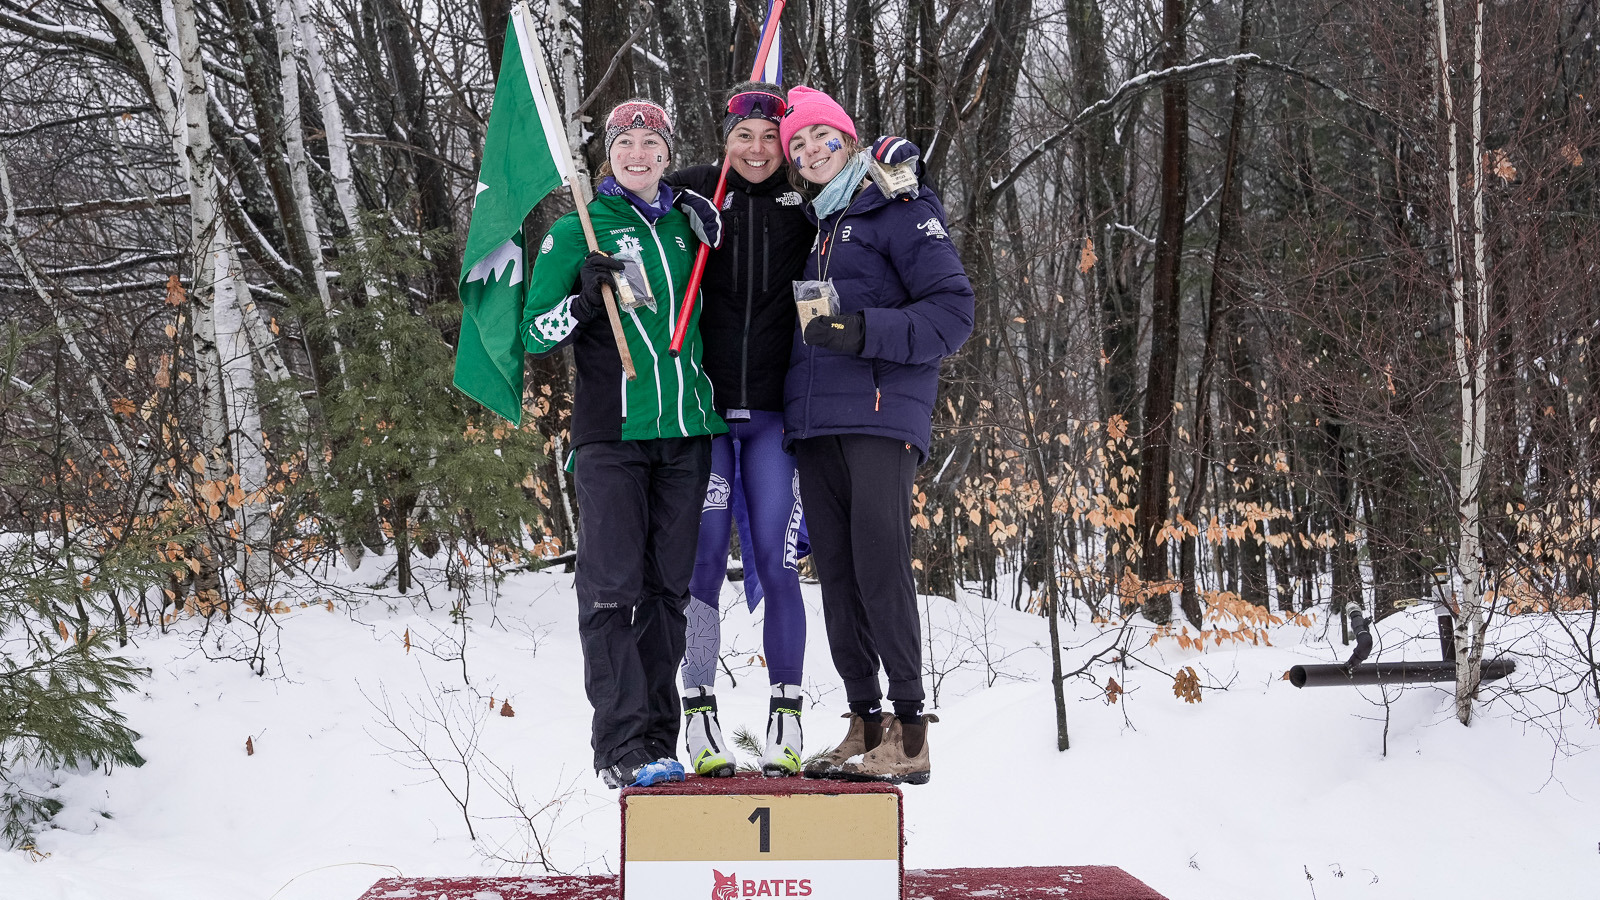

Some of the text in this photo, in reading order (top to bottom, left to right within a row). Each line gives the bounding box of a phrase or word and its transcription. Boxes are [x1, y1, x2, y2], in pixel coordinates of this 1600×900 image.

[785, 502, 803, 566] NEW
[748, 807, 770, 852] 1
[742, 879, 813, 897] BATES
